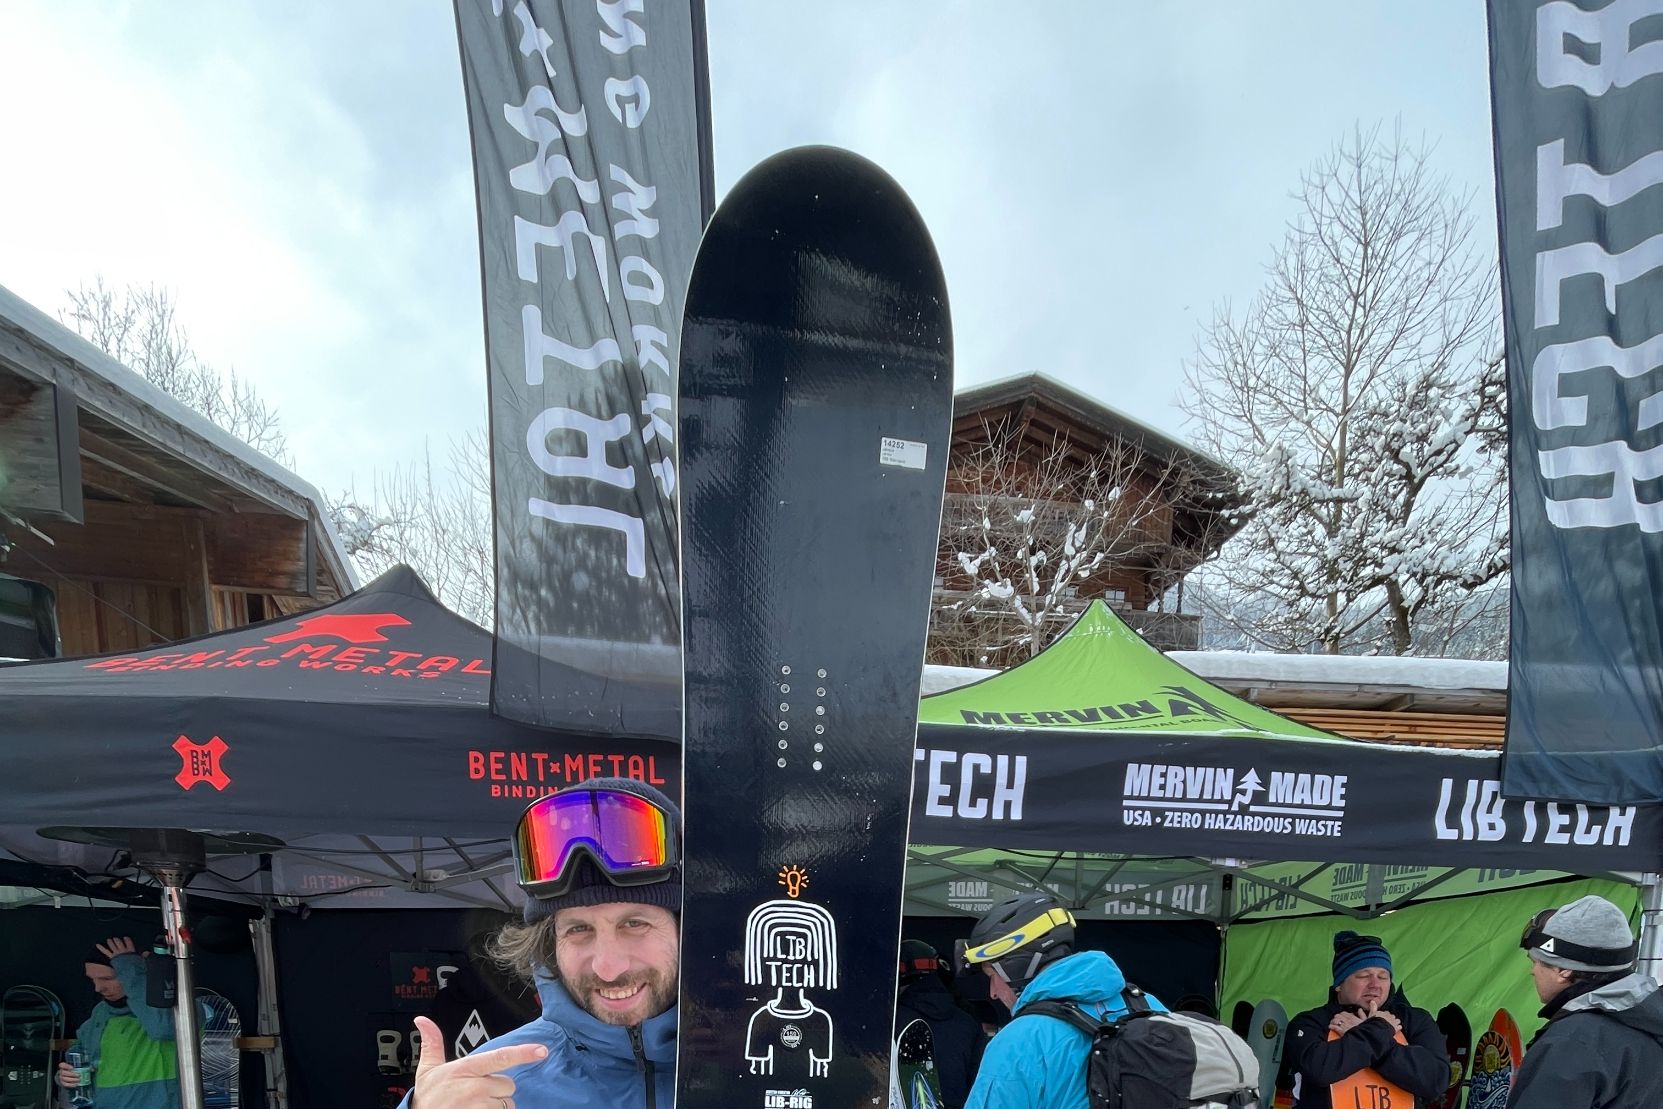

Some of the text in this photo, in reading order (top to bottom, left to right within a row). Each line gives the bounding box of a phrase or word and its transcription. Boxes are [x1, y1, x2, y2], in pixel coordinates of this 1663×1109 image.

[883, 439, 905, 450] 14252
[83, 643, 491, 674] BENT METAL
[299, 660, 441, 678] WORKS
[960, 700, 1162, 725] MERVIN
[491, 784, 559, 798] BINDIN
[915, 748, 1027, 820] ECH
[1123, 763, 1348, 807] MERVIN MADE
[1434, 778, 1507, 842] LIB
[1123, 810, 1342, 837] USA ZERO HAZARDOUS WASTE
[776, 935, 806, 960] LIB
[765, 961, 815, 988] TECH
[764, 1095, 813, 1109] LIB-RIG
